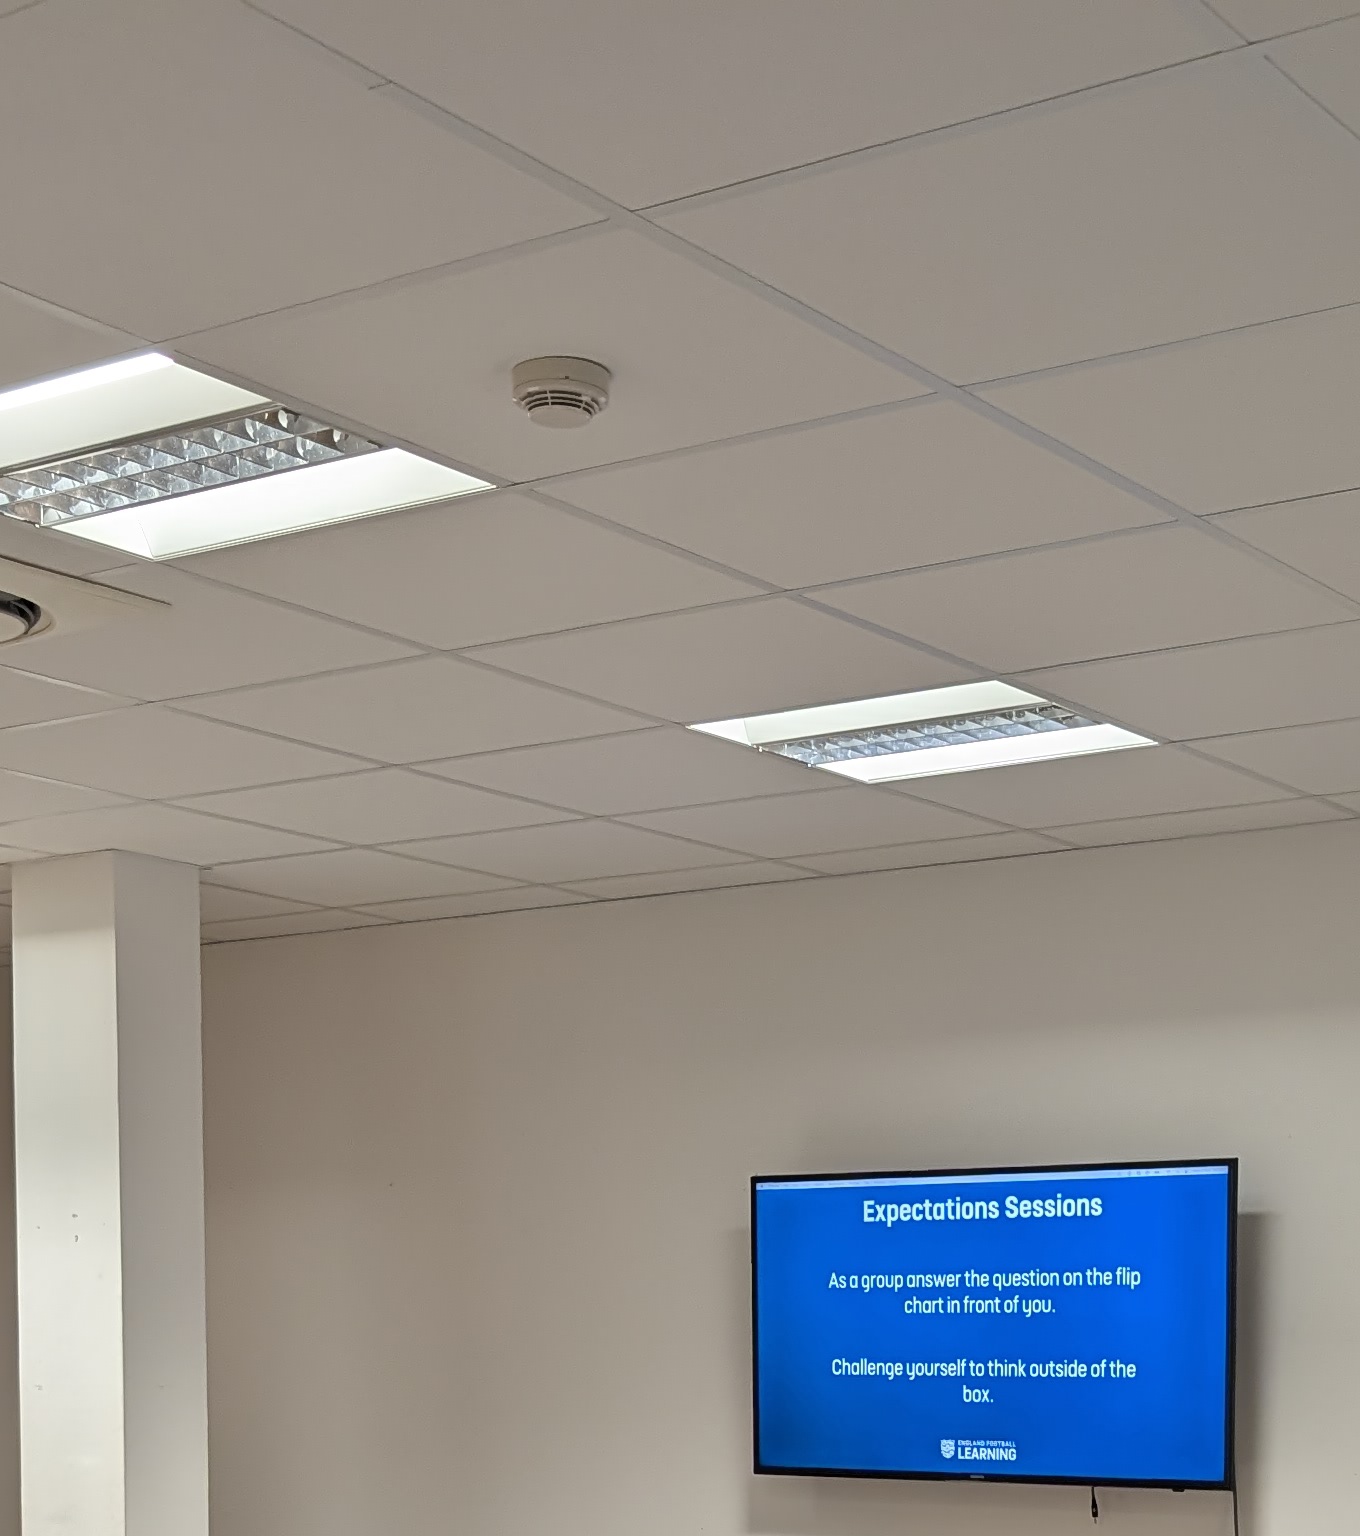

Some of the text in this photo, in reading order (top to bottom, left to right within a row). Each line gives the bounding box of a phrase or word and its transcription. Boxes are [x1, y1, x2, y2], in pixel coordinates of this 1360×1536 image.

[863, 1193, 1103, 1228] Expectations Sessions
[828, 1266, 1141, 1293] As a group answer the question on the flip
[904, 1294, 1056, 1318] chart in front of you.
[831, 1358, 1137, 1381] Challenge yourself to think outside of the
[962, 1385, 994, 1403] box.
[957, 1447, 1017, 1461] LEARNING
[986, 1440, 1017, 1448] FOOTBALL
